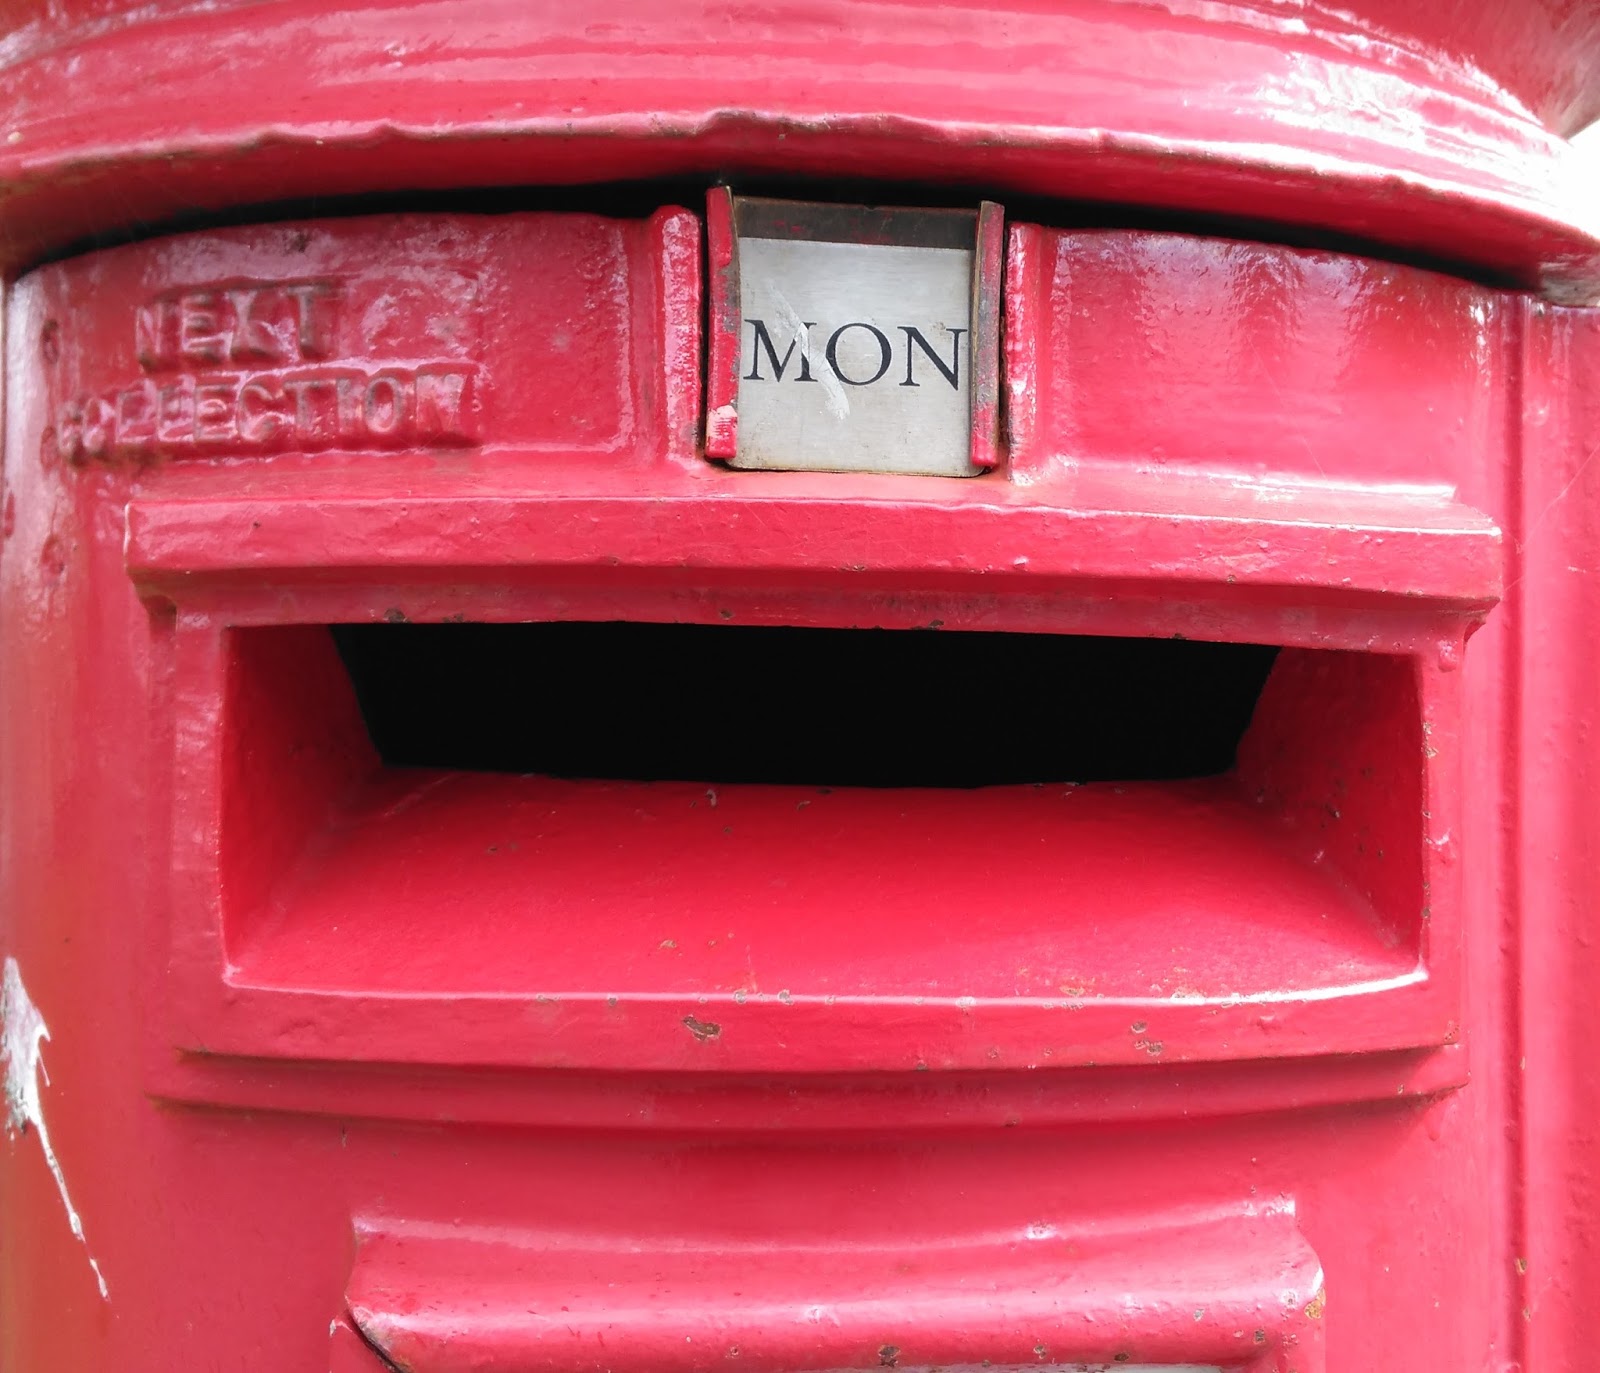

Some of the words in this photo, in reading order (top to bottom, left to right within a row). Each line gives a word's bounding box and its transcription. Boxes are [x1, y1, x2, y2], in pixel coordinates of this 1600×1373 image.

[135, 282, 334, 366] NEXT
[743, 319, 967, 391] MON
[57, 368, 473, 457] COLLECTION
